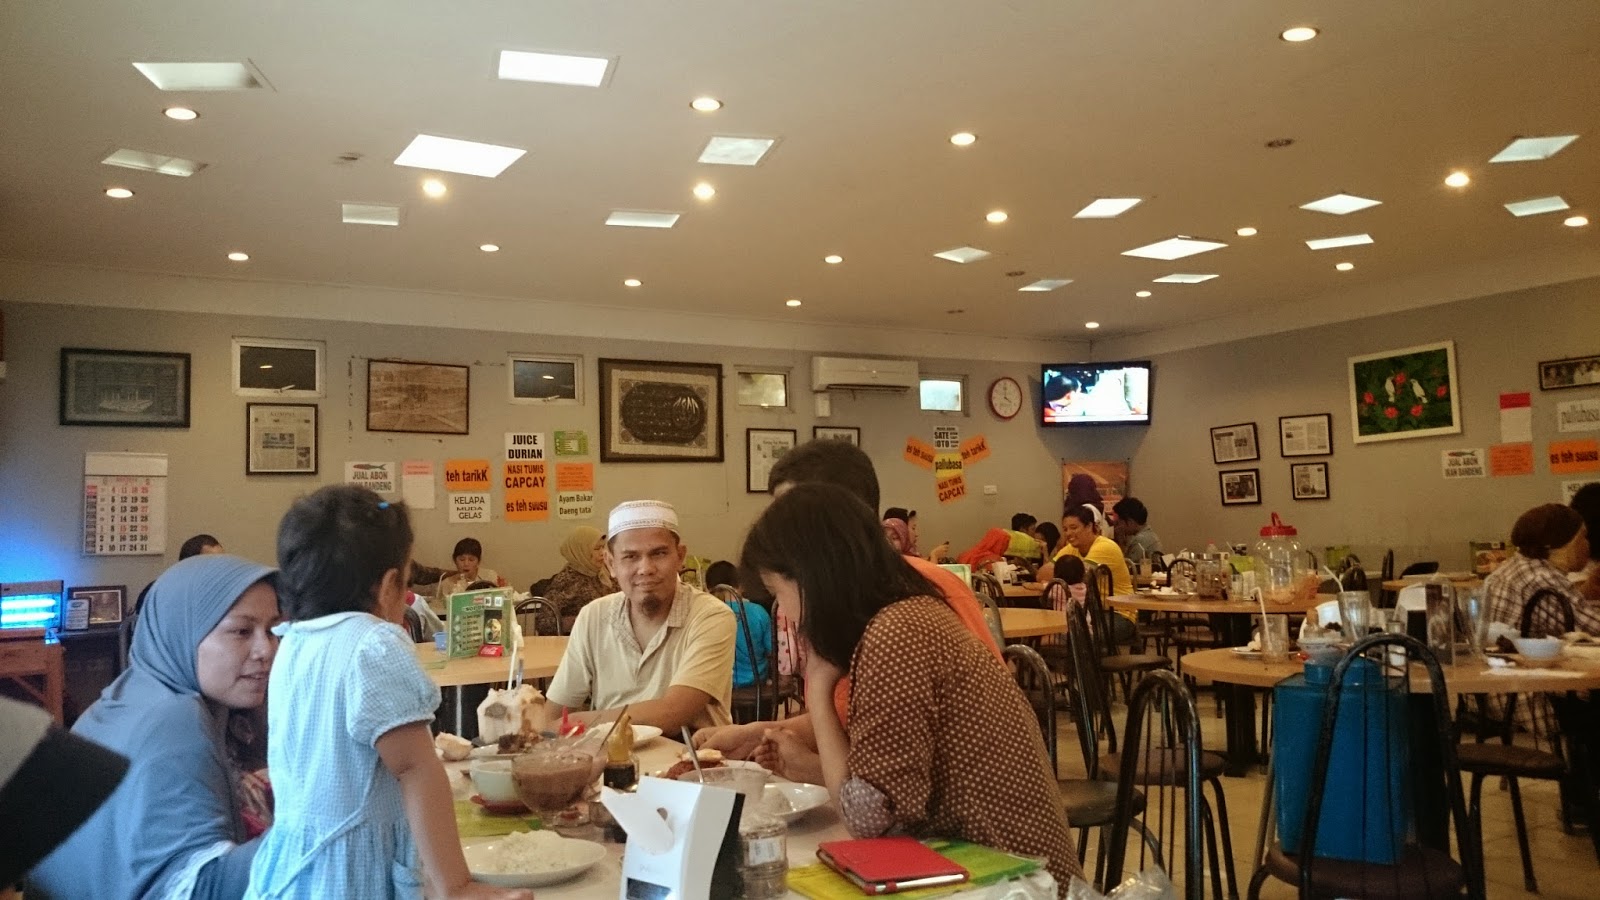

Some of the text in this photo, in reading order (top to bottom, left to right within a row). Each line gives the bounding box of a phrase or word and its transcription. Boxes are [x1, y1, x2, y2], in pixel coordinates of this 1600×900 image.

[512, 435, 537, 444] JUICE
[508, 449, 542, 459] DURIAN
[508, 465, 544, 474] NASI TUMIS
[353, 471, 388, 479] JUAL ABON
[446, 470, 460, 482] teh
[505, 477, 545, 488] CAPCAY
[454, 496, 485, 504] KELAPA
[559, 494, 593, 504] Ayam Bakar
[506, 502, 514, 512] es
[516, 499, 527, 511] teh
[560, 508, 578, 516] Daeng
